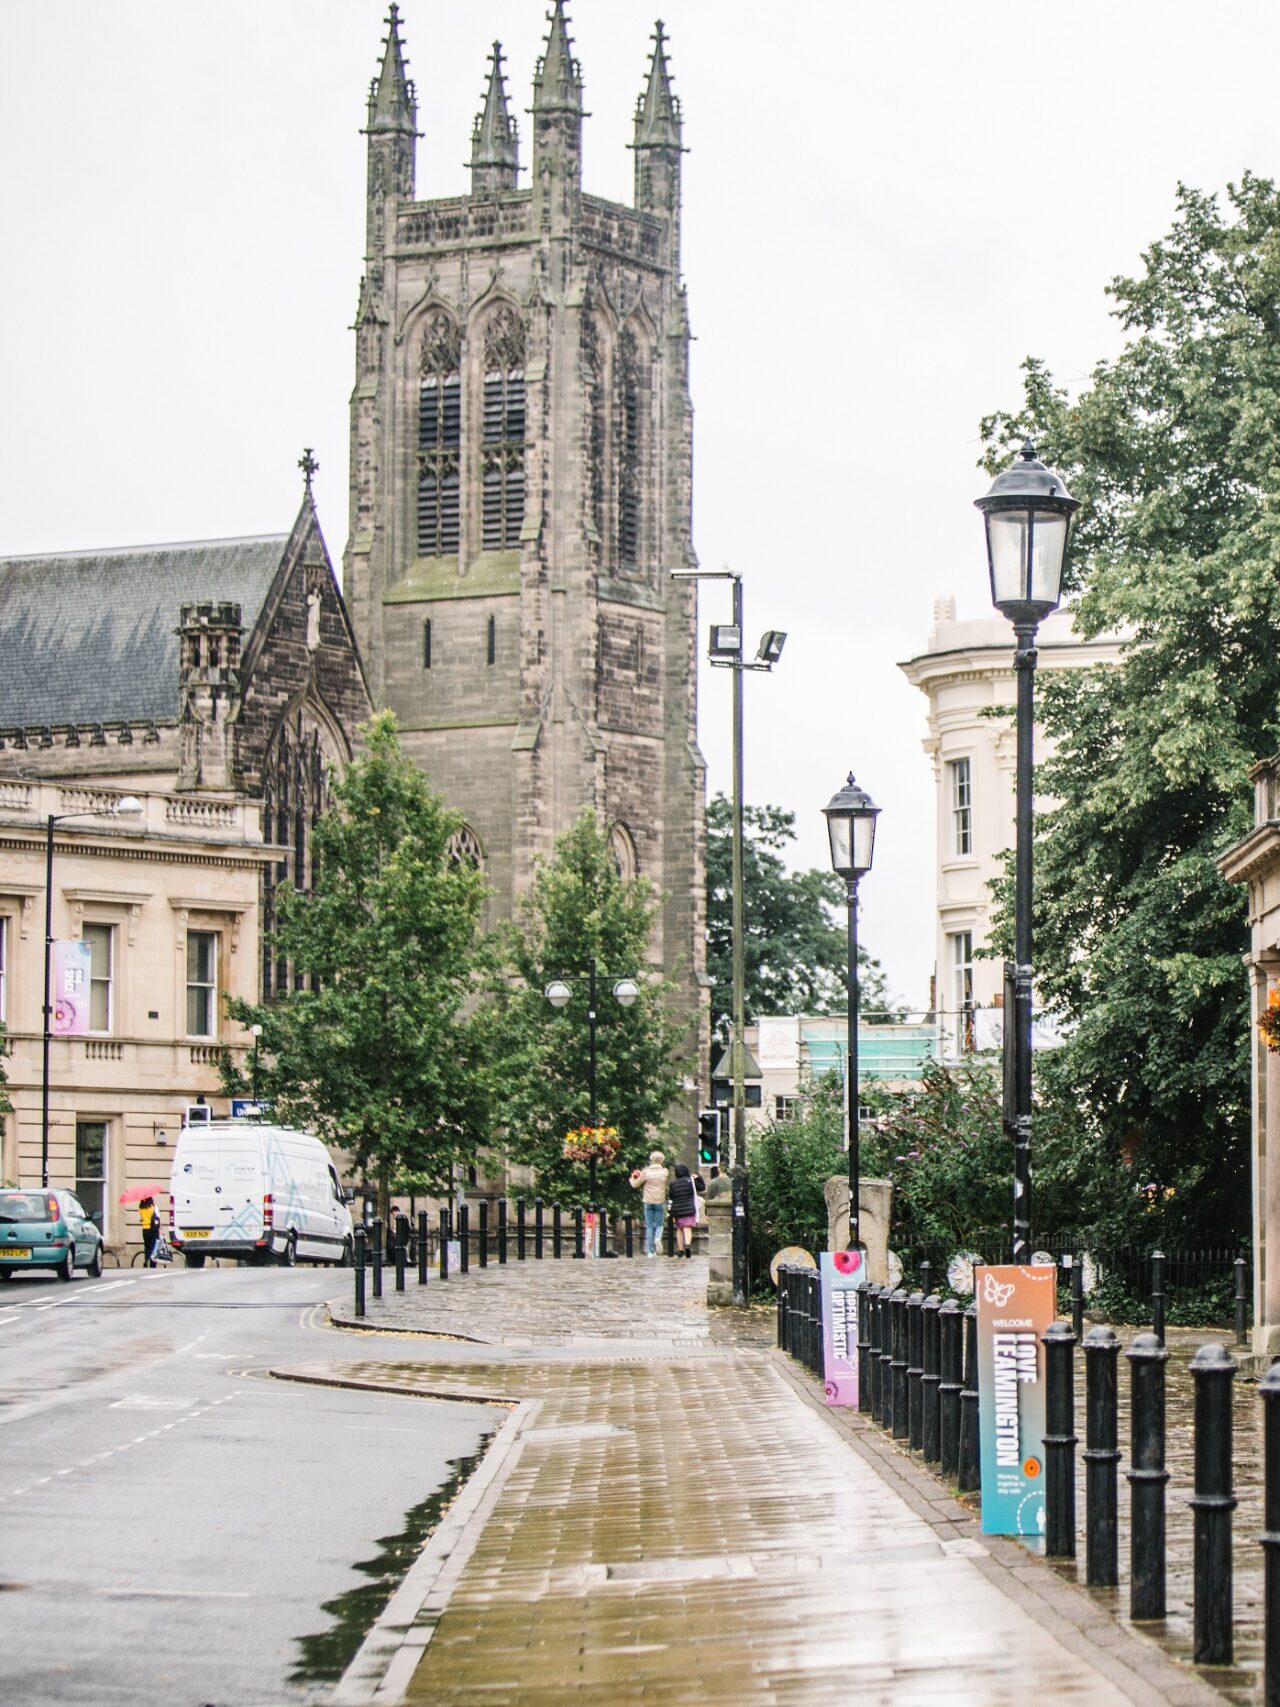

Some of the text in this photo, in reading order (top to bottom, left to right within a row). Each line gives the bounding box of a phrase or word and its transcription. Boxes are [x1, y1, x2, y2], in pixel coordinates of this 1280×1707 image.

[831, 1290, 848, 1360] OPTIMISTIC
[845, 1290, 858, 1332] OPEN &
[992, 1319, 1033, 1328] WELCOME
[1016, 1333, 1037, 1383] LOVE
[993, 1333, 1019, 1466] LEAMINGTON
